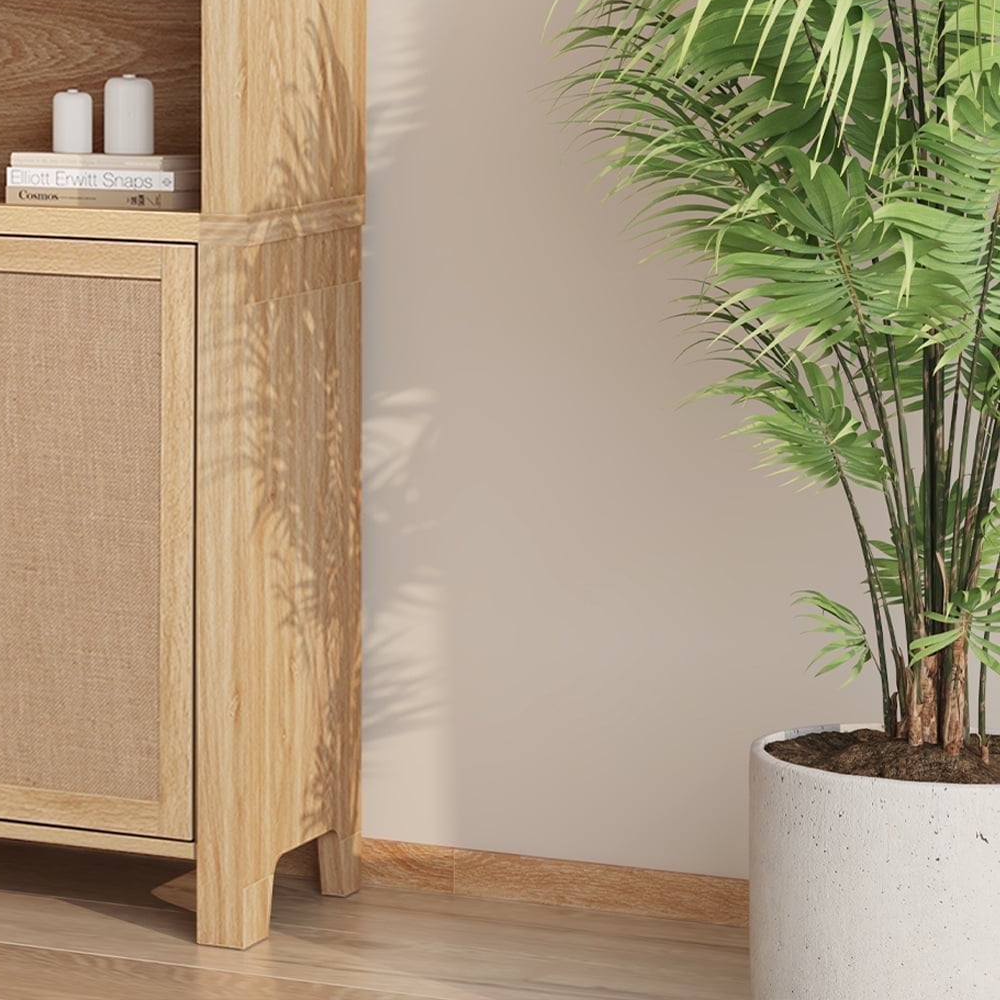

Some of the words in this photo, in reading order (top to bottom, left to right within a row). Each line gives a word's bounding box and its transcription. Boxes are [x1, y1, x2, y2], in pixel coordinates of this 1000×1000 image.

[10, 168, 50, 186] Elliott
[55, 169, 97, 187] Erwitt
[102, 171, 154, 190] Snaps
[18, 188, 60, 201] Cosmos
